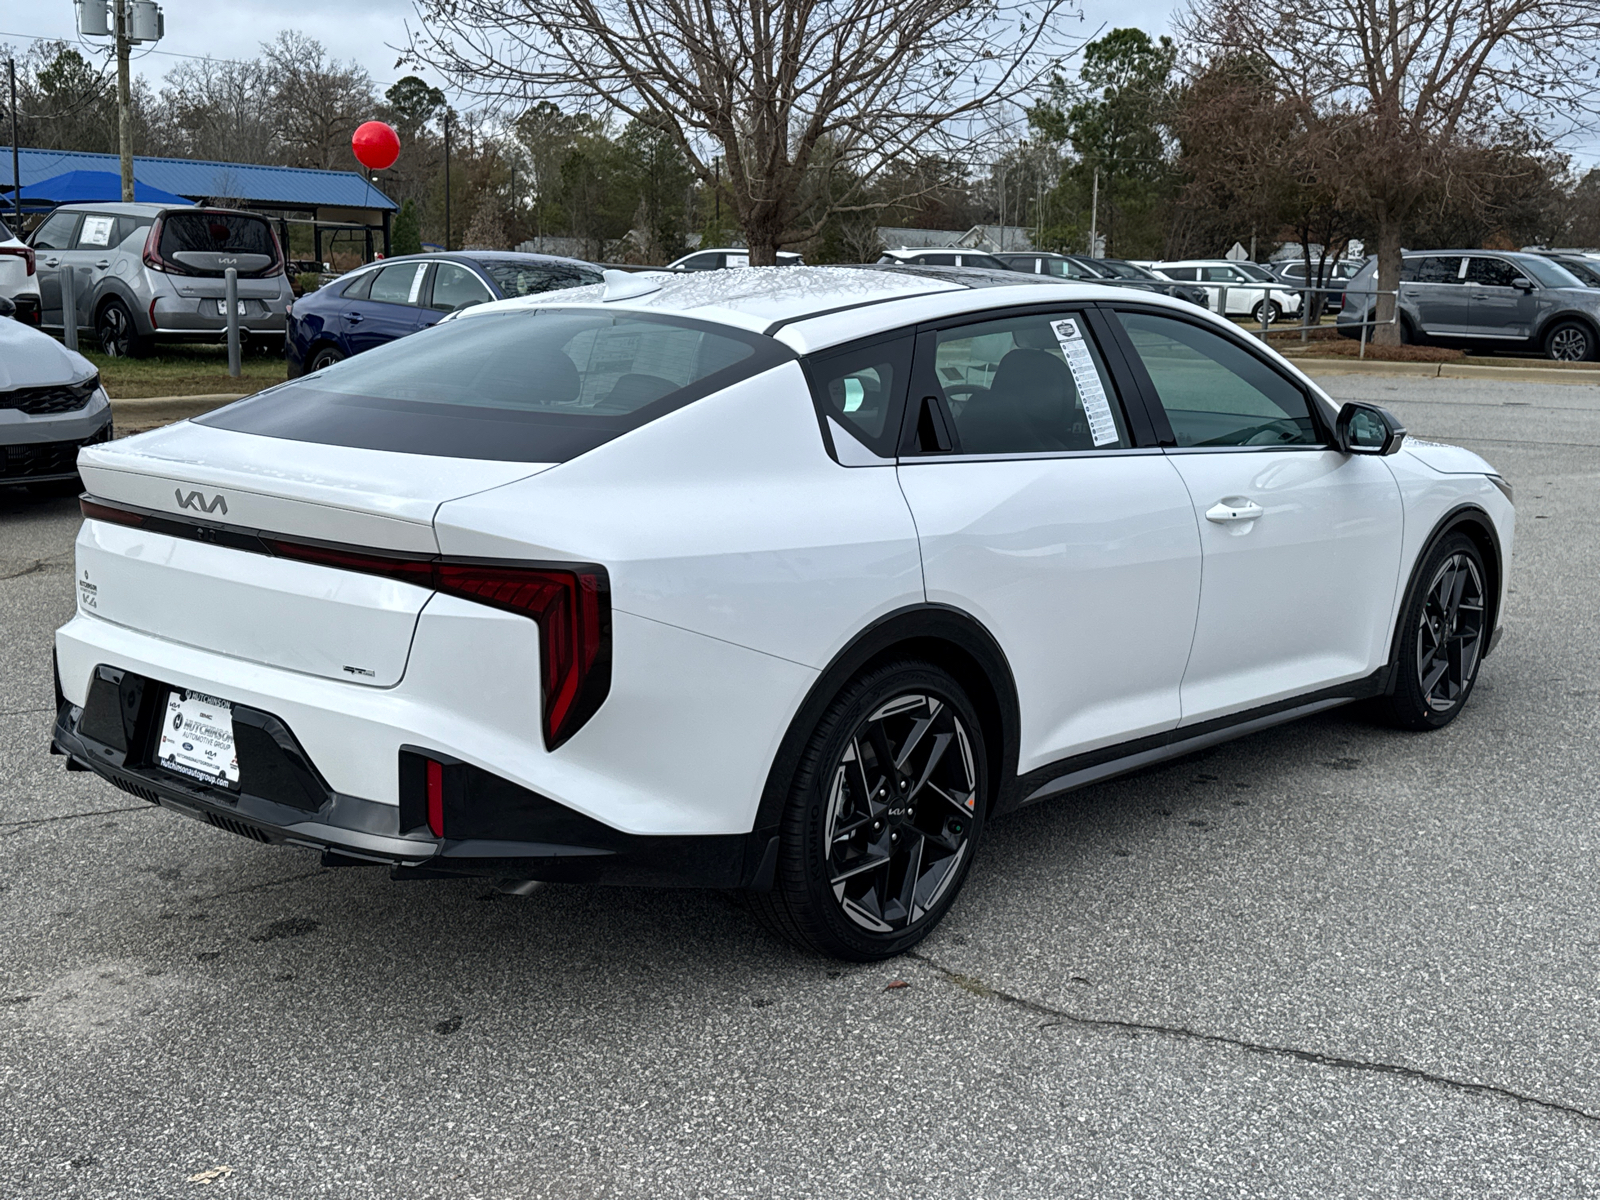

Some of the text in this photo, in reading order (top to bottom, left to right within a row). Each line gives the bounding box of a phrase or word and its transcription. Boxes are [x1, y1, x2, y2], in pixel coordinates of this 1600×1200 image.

[175, 488, 228, 515] KIA
[82, 593, 97, 608] K4
[192, 692, 231, 709] HUTCHINSON
[182, 731, 231, 751] AUTOMOTIVE GROUP
[809, 804, 821, 882] KUMHO
